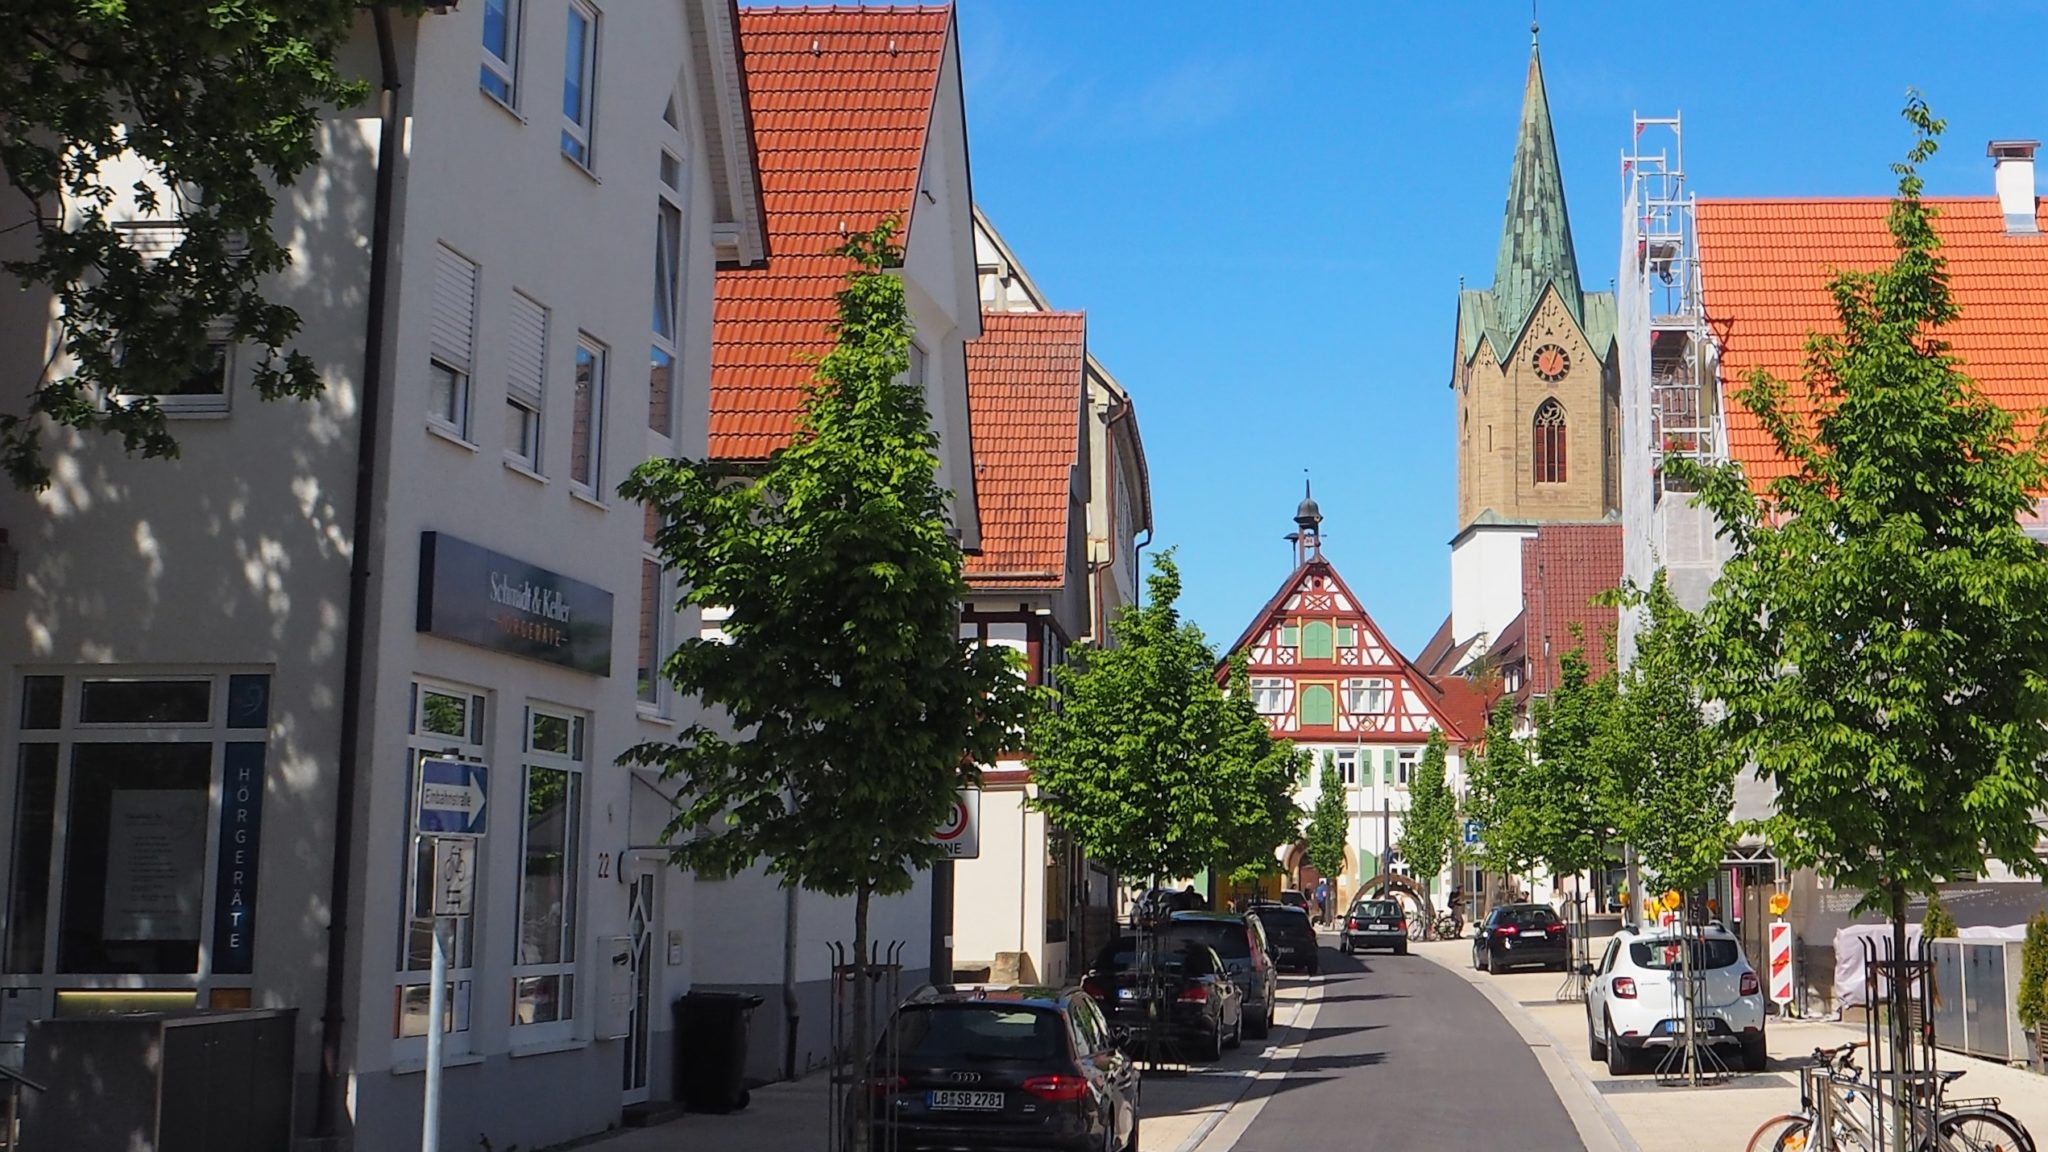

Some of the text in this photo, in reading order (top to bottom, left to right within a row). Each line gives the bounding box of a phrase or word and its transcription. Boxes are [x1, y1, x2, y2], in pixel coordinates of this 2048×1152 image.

[490, 571, 571, 623] Schmidt & Keller
[230, 768, 250, 948] HÖRGERÄTE
[598, 853, 609, 878] 22
[934, 1091, 1003, 1107] LB SB 2781
